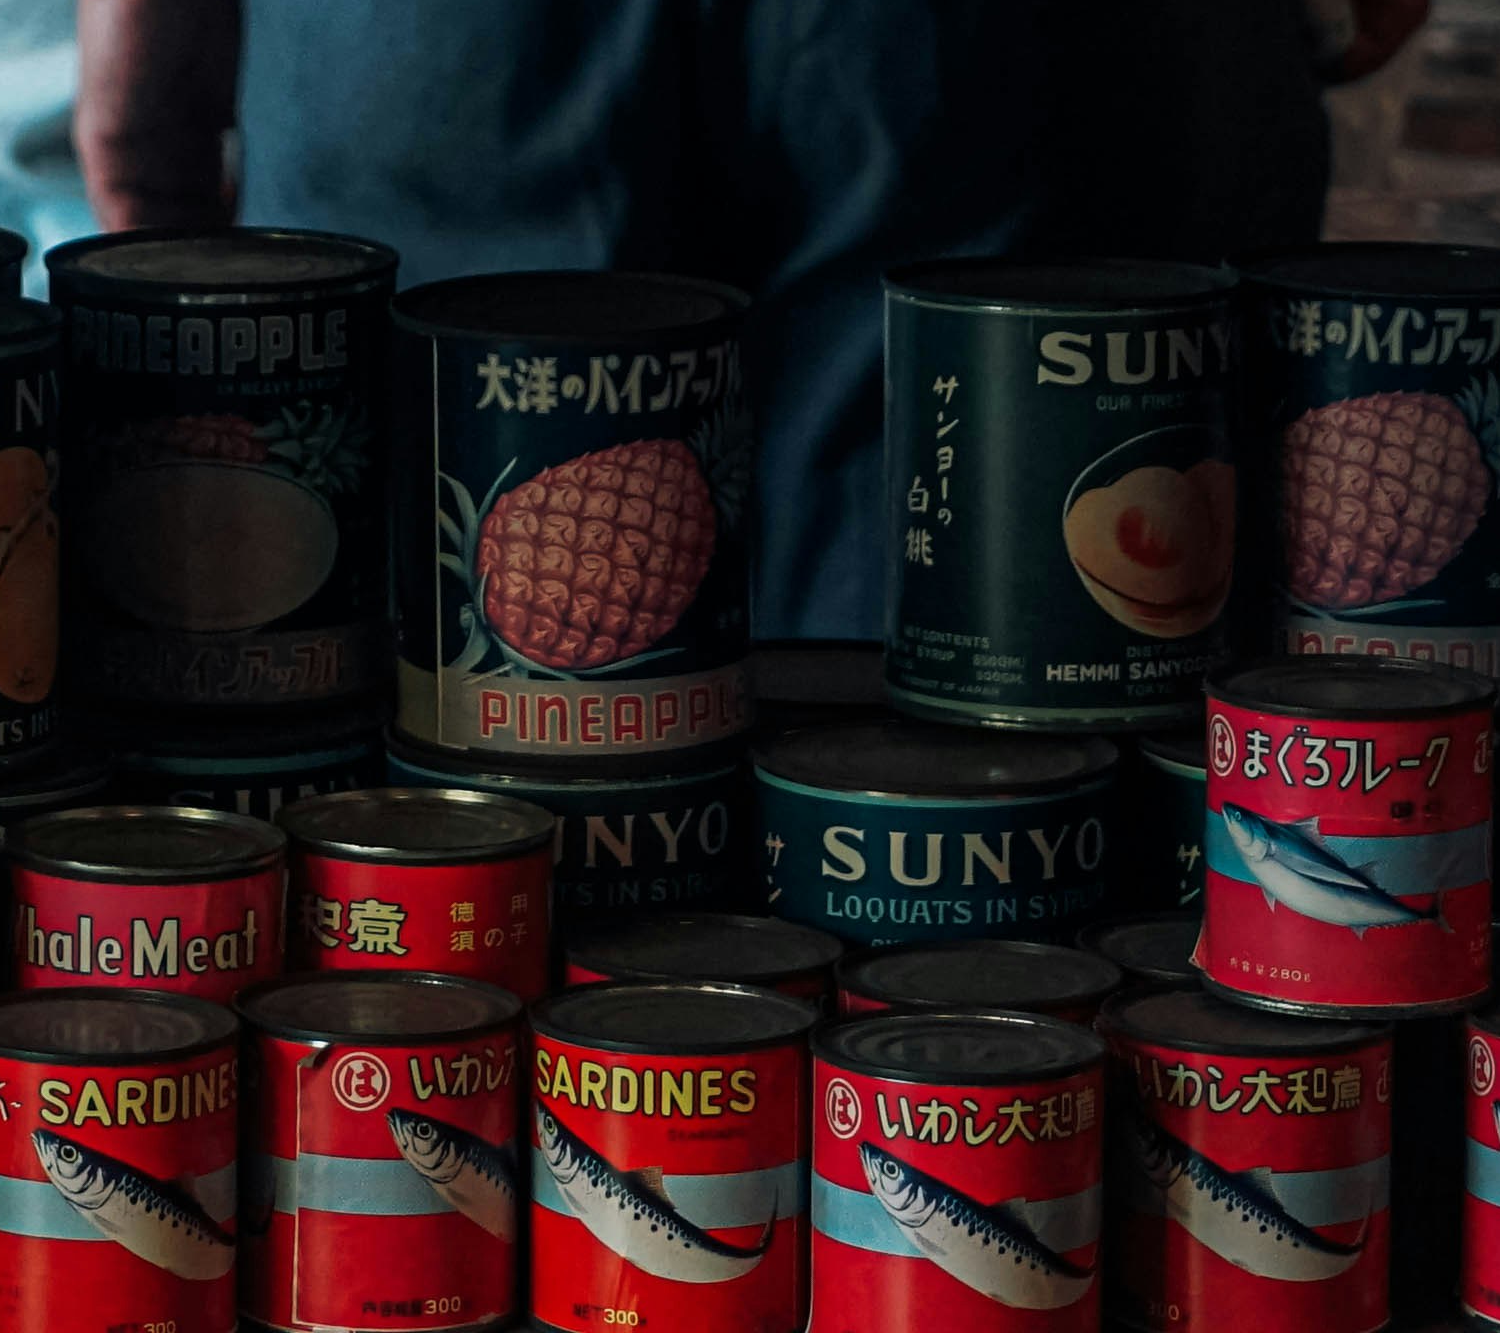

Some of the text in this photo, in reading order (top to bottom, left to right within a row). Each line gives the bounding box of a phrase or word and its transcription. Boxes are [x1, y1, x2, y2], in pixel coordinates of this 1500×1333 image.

[72, 308, 349, 378] PINEAPPLE
[477, 341, 743, 416] 大洋のパインアップル
[1095, 395, 1133, 413] OUR
[932, 375, 961, 529] サンヨーの
[905, 474, 934, 568] 白桃
[1045, 663, 1121, 684] HEMMI
[821, 816, 1105, 889] SUNYO
[606, 879, 642, 909] IN
[825, 888, 1019, 928] LOQUATS IN
[131, 909, 260, 977] Meat
[535, 1047, 758, 1120] SARDINES
[875, 1090, 1099, 1148] いわし大和煮
[425, 1294, 464, 1316] 300
[603, 1308, 640, 1327] 300
